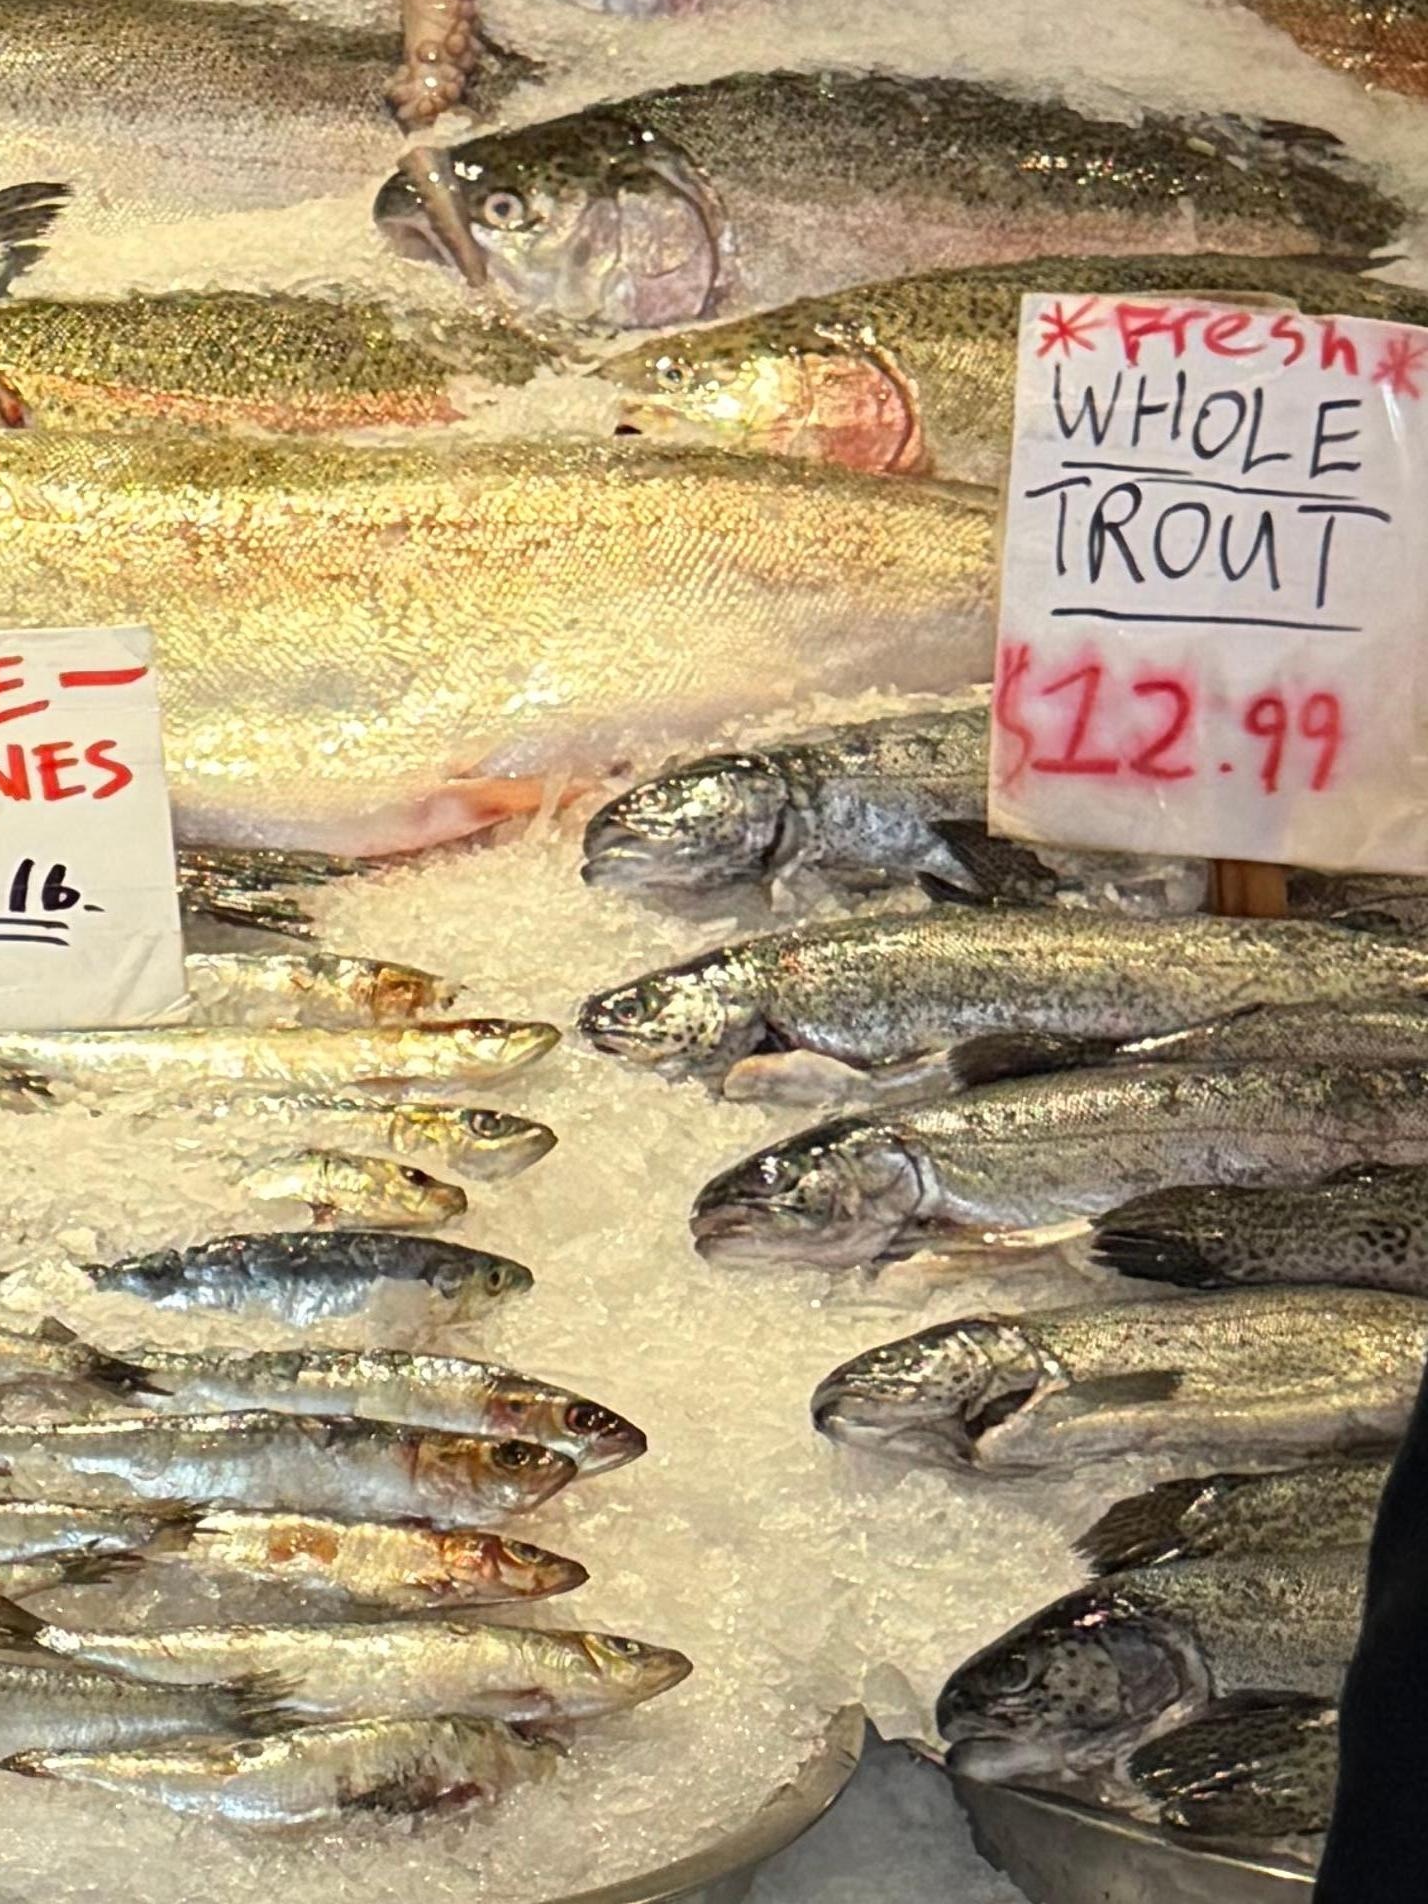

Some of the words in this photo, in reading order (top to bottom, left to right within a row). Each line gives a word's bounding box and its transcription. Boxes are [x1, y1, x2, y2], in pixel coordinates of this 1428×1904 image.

[1052, 363, 1362, 479] WHOLE
[1024, 476, 1392, 608] TROUT
[994, 642, 1343, 795] $12.99
